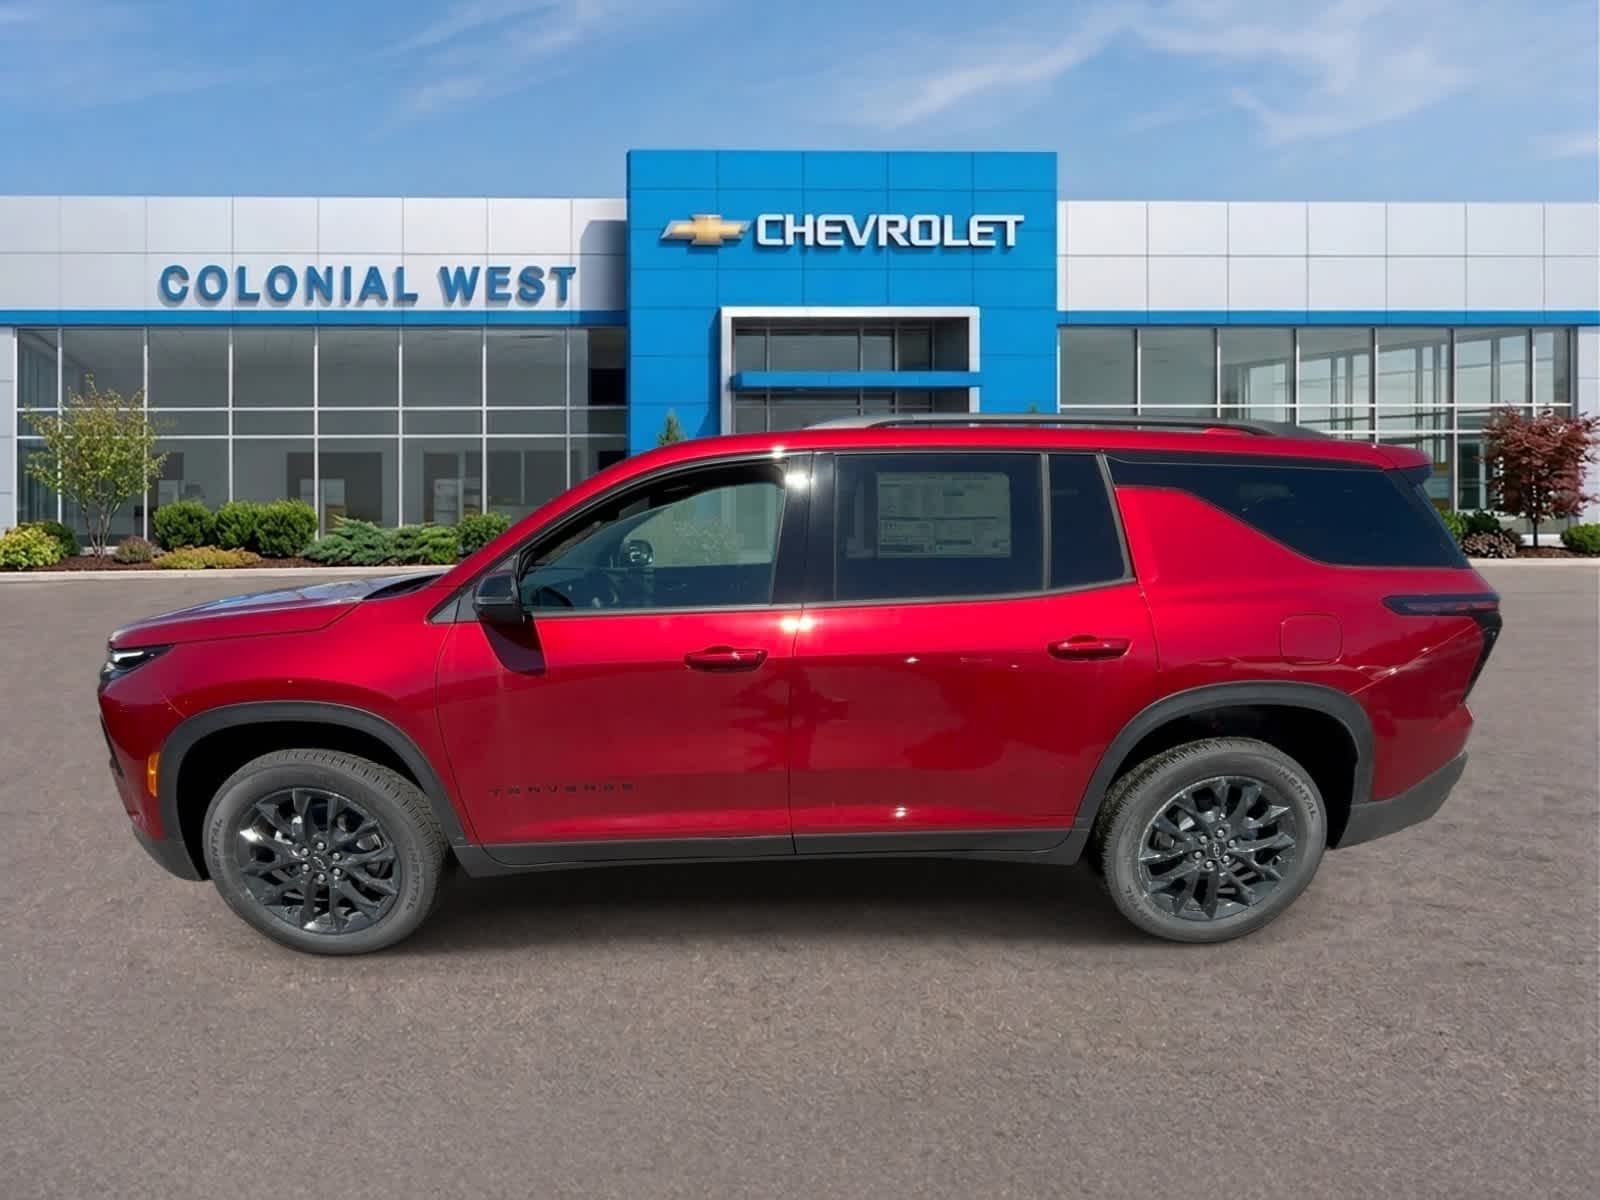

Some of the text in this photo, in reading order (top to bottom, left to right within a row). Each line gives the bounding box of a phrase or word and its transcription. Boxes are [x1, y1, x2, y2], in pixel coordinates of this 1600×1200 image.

[756, 213, 1025, 248] CHEVROLET
[160, 264, 577, 303] COLONIAL WEST
